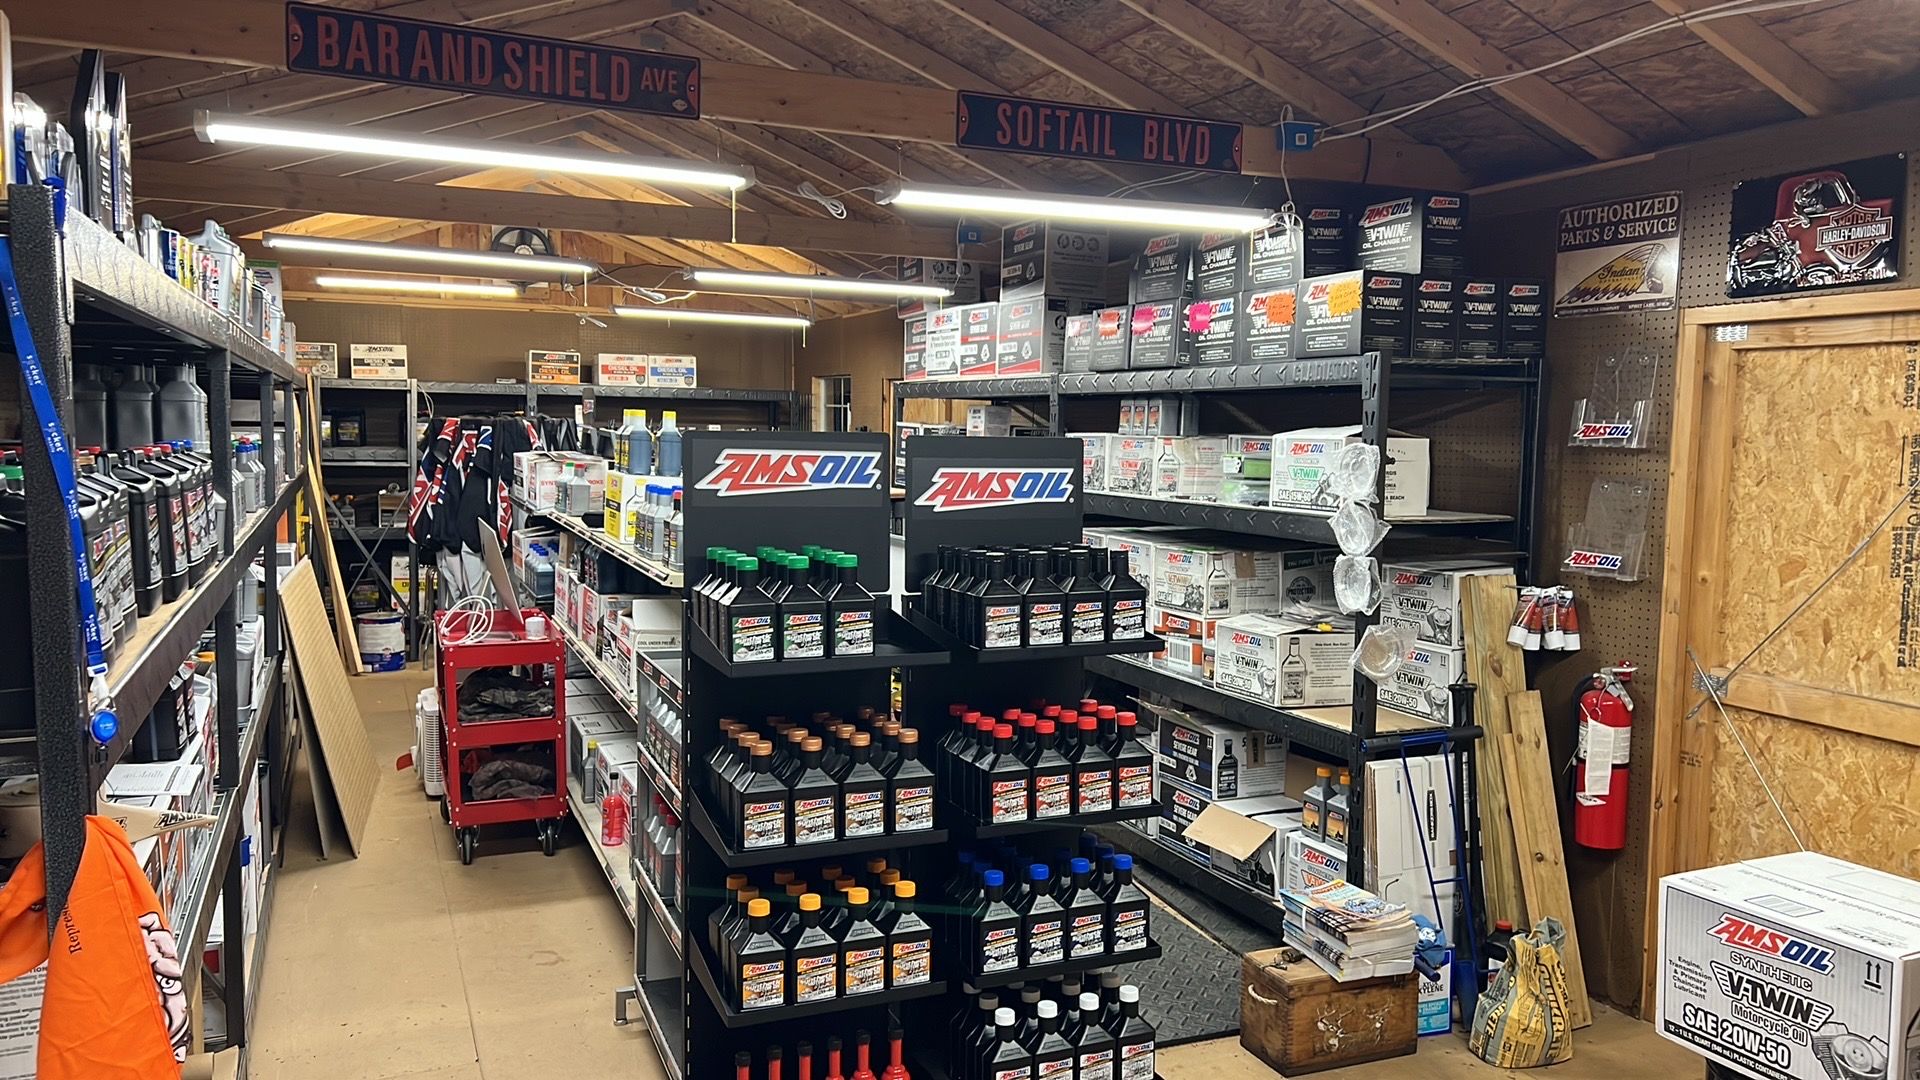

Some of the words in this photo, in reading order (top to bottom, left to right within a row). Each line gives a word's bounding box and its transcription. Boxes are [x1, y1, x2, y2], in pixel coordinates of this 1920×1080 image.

[316, 15, 398, 76] BAR
[410, 30, 493, 86] AND
[503, 41, 631, 102] SHIELD
[640, 67, 678, 95] AVE
[996, 103, 1116, 156] SOFTAIL
[1143, 119, 1210, 165] BLVD
[1431, 198, 1460, 207] AMSOIL
[1311, 210, 1340, 219] AMSOIL
[1364, 201, 1413, 224] AMSOIL
[1561, 195, 1679, 230] AUTHORIZED
[1432, 216, 1459, 225] V-TWIN
[1369, 223, 1406, 242] V-TWIN
[1561, 228, 1600, 246] PARTS
[1603, 225, 1614, 240] &
[1618, 217, 1676, 238] SERVICE
[1823, 224, 1887, 243] HARLEY-DAVIDSON
[1147, 234, 1179, 253] AMSOIL
[1374, 238, 1400, 248] CHANGE
[1151, 253, 1174, 267] V-TWIN
[1206, 247, 1233, 264] V-TWIN
[1598, 264, 1639, 279] Indian
[1370, 278, 1401, 287] AMSOIL
[1421, 282, 1452, 291] AMSOIL
[1466, 284, 1495, 293] AMSOIL
[1511, 286, 1539, 295] AMSOIL
[1373, 297, 1400, 306] V-TWIN
[1424, 300, 1450, 309] V-TWIN
[1468, 303, 1494, 311] V-TWIN
[1513, 304, 1538, 313] V-TWIN
[1576, 424, 1631, 438] AMSOIL
[1242, 441, 1270, 452] AMSOIL
[1290, 443, 1324, 455] AMSOIL
[708, 453, 876, 492] AMSOIL
[1293, 468, 1319, 478] V-TWIN
[925, 472, 1069, 508] AMSOIL
[1168, 553, 1192, 564] AMSOIL
[1568, 552, 1620, 566] AMSOIL
[1394, 573, 1432, 586] AMSOIL
[1033, 604, 1061, 613] AMSOIL
[1075, 603, 1102, 611] AMSOIL
[1116, 600, 1141, 609] AMSOIL
[1399, 598, 1427, 610] V-TWIN
[841, 613, 870, 621] AMSOIL
[990, 607, 1018, 616] AMSOIL
[739, 618, 769, 626] AMSOIL
[791, 615, 821, 623] AMSOIL
[1167, 617, 1189, 628] AMSOIL
[1232, 633, 1261, 646] AMSOIL
[1236, 655, 1258, 669] V-TWIN
[1396, 672, 1424, 687] V-TWIN
[1380, 689, 1392, 701] SAE
[1393, 693, 1417, 708] 20W-50
[1174, 728, 1199, 744] AMSOIL
[1084, 772, 1110, 781] AMSOIL
[1125, 767, 1150, 776] AMSOIL
[997, 780, 1025, 790] AMSOIL
[1041, 776, 1068, 785] AMSOIL
[850, 792, 882, 802] AMSOIL
[900, 787, 931, 798] AMSOIL
[800, 798, 832, 810] AMSOIL
[1174, 791, 1199, 810] AMSOIL
[749, 802, 783, 813] AMSOIL
[1302, 850, 1340, 871] AMSOIL
[1076, 916, 1101, 925] AMSOIL
[1119, 911, 1144, 920] AMSOIL
[63, 903, 82, 954] Repres
[1036, 922, 1061, 931] AMSOIL
[990, 929, 1016, 939] AMSOIL
[899, 942, 929, 952] AMSOIL
[1714, 915, 1833, 972] AMSOIL
[851, 949, 882, 960] AMSOIL
[803, 956, 833, 967] AMSOIL
[1678, 956, 1703, 971] Engine,
[749, 963, 781, 973] AMSOIL
[1669, 959, 1712, 981] Transmission
[1731, 952, 1812, 991] SYNTHETIC
[1673, 975, 1707, 993] Chaincase
[1680, 971, 1707, 986] Primary
[1674, 983, 1706, 1000] Lubricant
[1728, 971, 1814, 1024] V-TWIN
[1734, 1005, 1789, 1036] Motorcycle
[1792, 1028, 1805, 1043] Oil
[1684, 1004, 1718, 1038] SAE
[1721, 1019, 1791, 1069] 20W-50
[1126, 1042, 1154, 1053] AMSOIL
[1694, 1035, 1711, 1048] QUART
[1734, 1053, 1755, 1068] PLASTIC
[1085, 1051, 1112, 1063] AMSOIL
[1044, 1058, 1072, 1071] AMSOIL
[1001, 1067, 1031, 1080] AMSOIL
